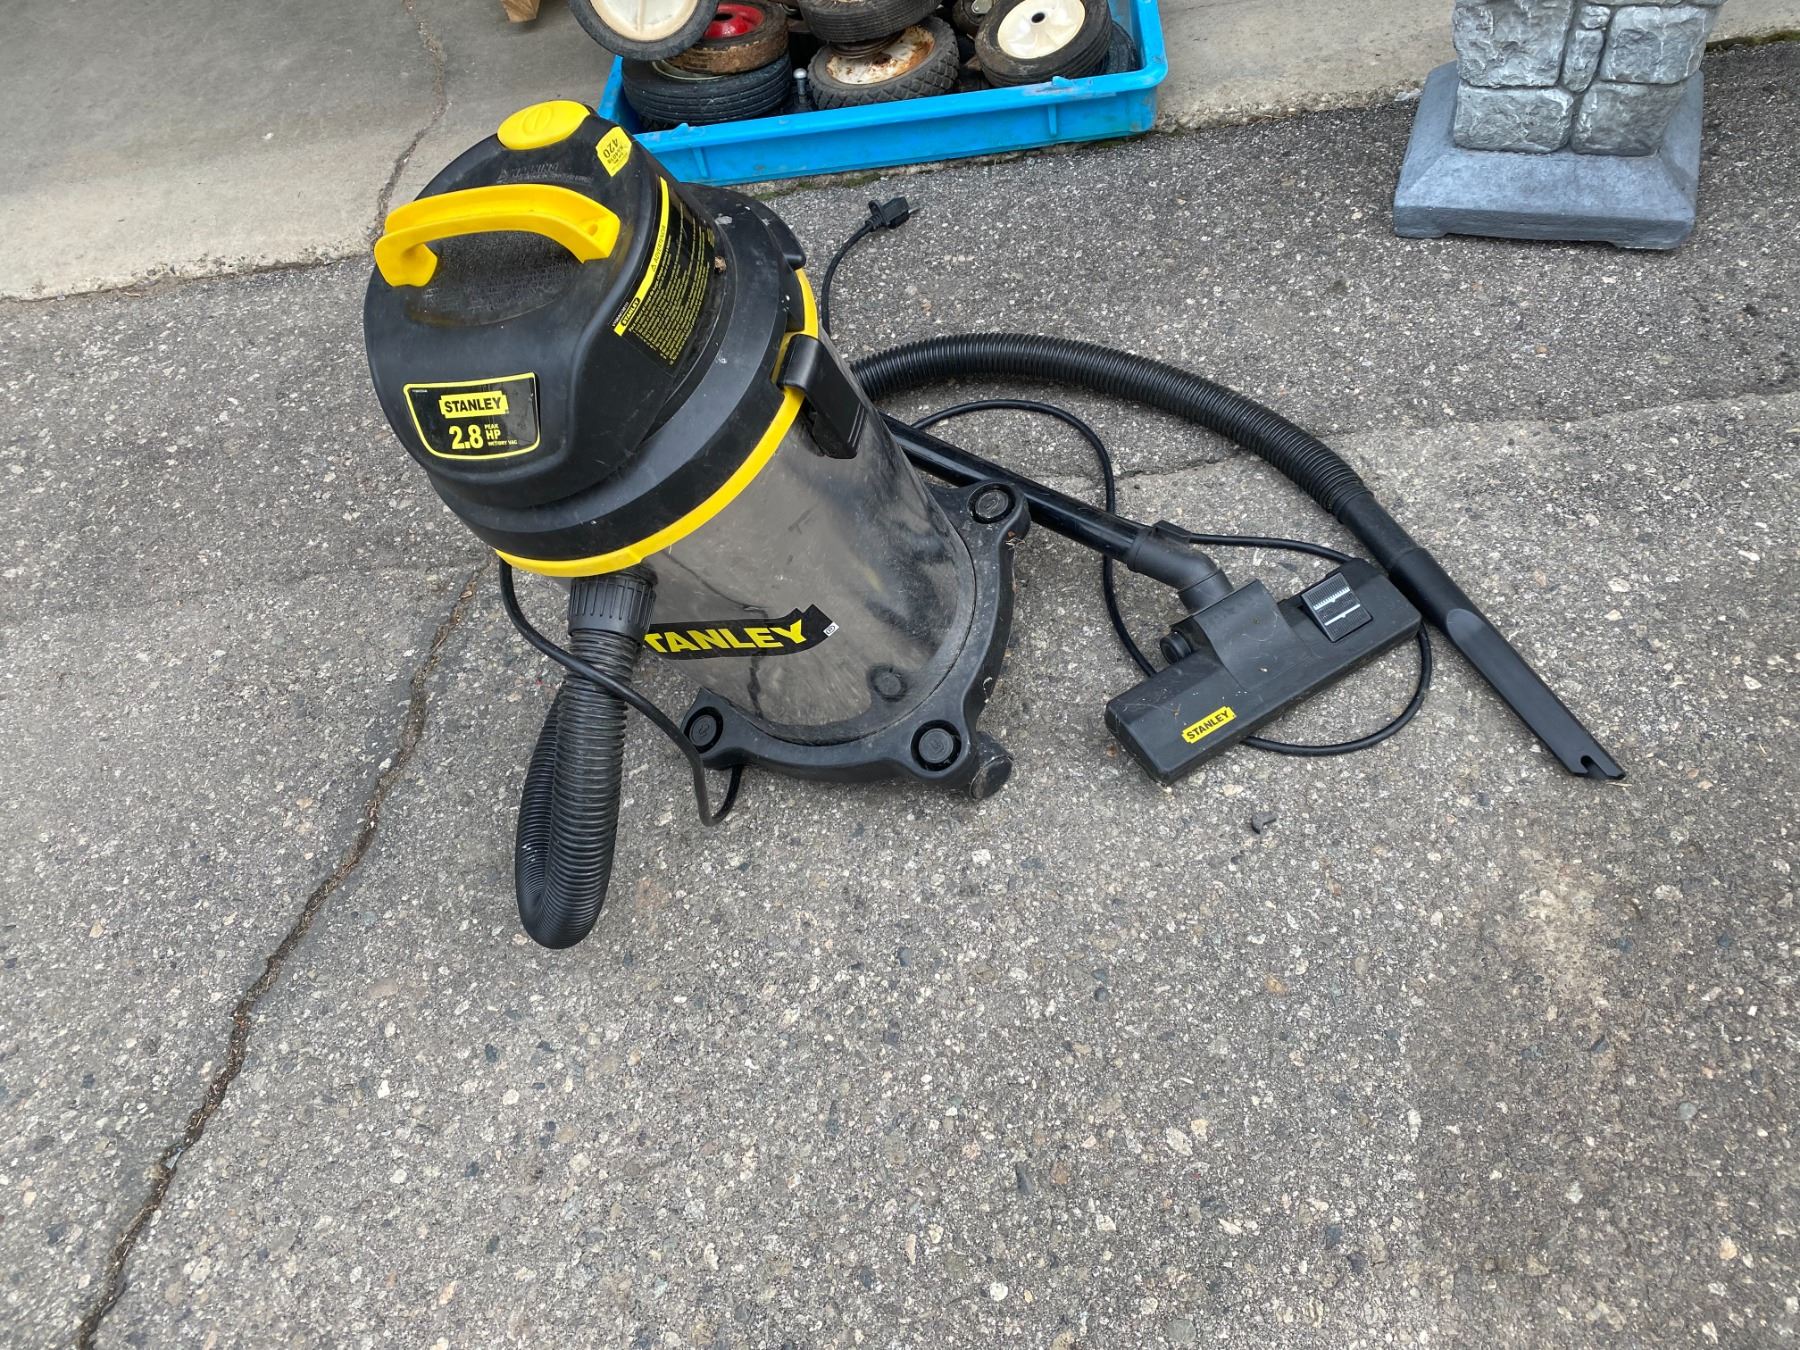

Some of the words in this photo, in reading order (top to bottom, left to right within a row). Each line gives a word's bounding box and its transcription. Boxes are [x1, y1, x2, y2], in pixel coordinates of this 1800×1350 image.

[603, 138, 618, 158] 420
[444, 397, 501, 413] STANLEY
[449, 424, 483, 450] 2.8
[485, 430, 501, 440] HP
[644, 619, 807, 653] TANLEY
[1186, 710, 1229, 739] STANLEY
